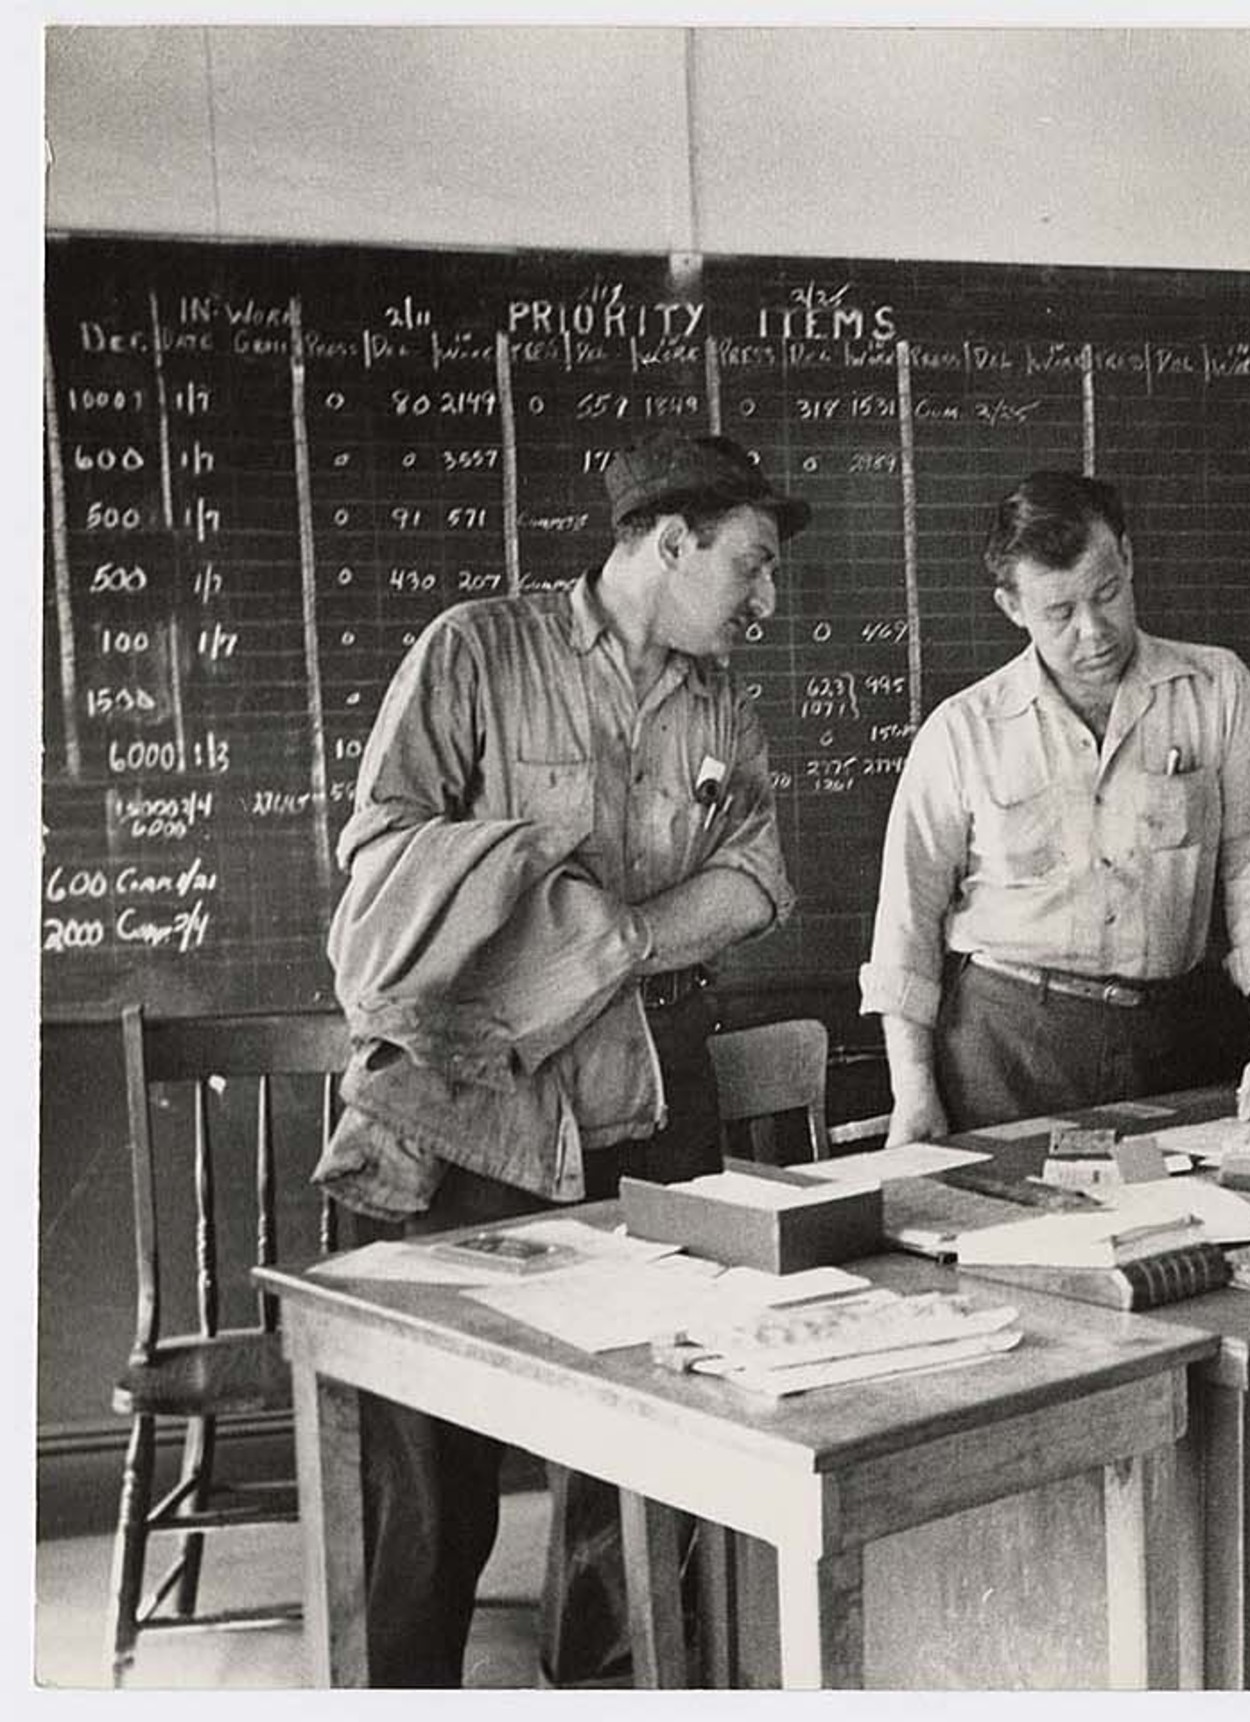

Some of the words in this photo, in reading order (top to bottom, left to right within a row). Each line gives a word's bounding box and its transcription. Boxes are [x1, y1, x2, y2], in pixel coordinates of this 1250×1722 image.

[508, 299, 704, 338] PRIORITY
[759, 305, 897, 341] ITEMS
[391, 390, 431, 416] 80
[74, 445, 145, 470] 600
[86, 502, 141, 531] 500
[391, 507, 421, 530] 91
[447, 507, 487, 528] 571
[89, 561, 148, 593] 500
[389, 568, 437, 590] 430
[102, 629, 150, 653] 100
[108, 740, 176, 773] 6000
[46, 865, 108, 903] 600
[42, 917, 104, 952] 2000
